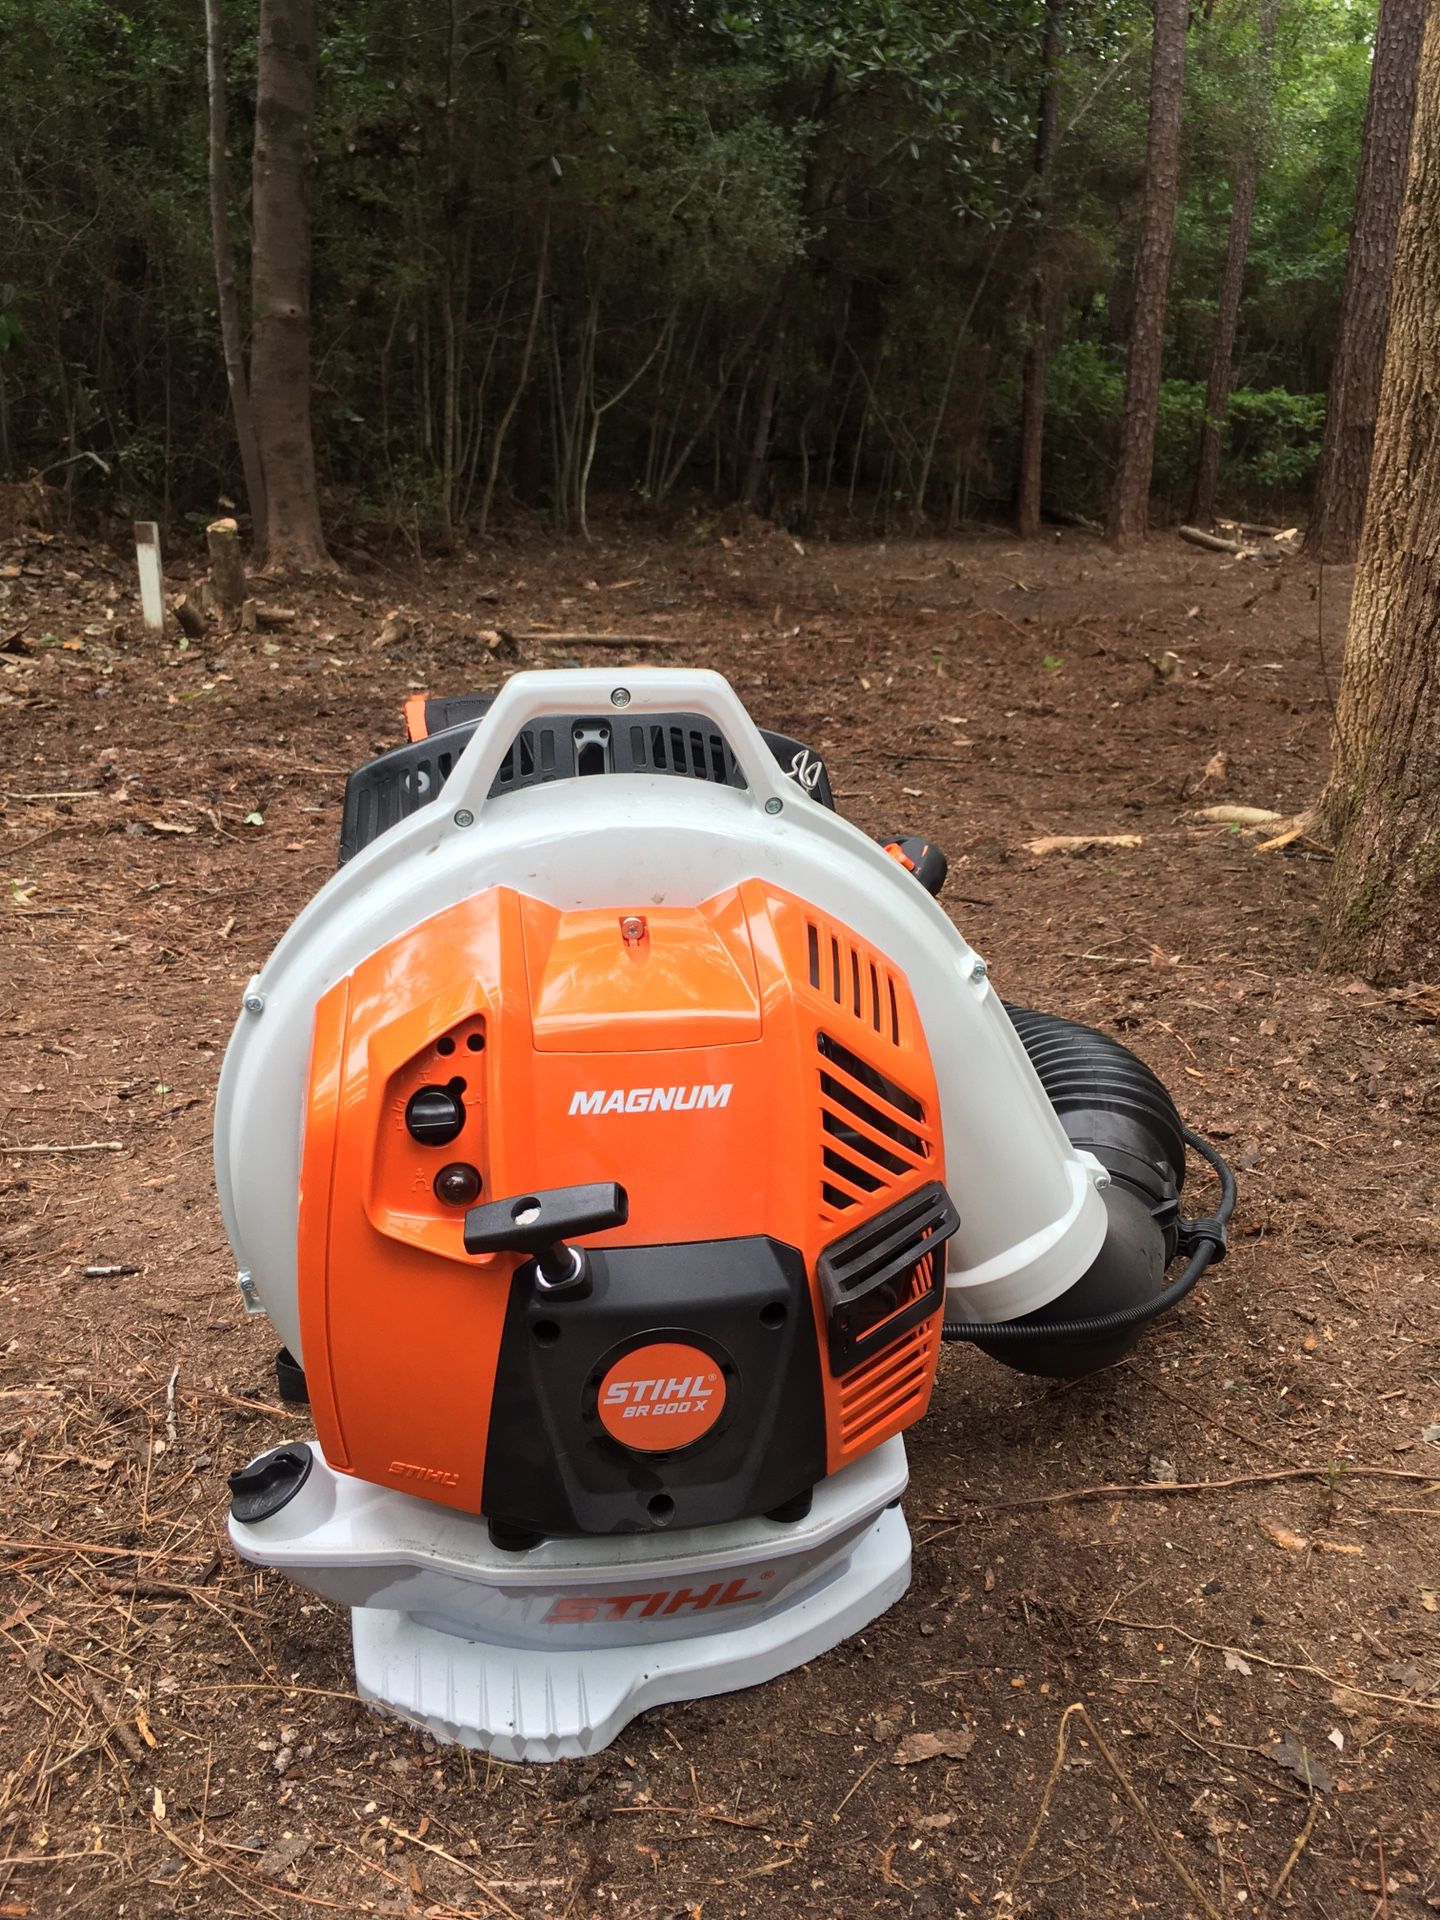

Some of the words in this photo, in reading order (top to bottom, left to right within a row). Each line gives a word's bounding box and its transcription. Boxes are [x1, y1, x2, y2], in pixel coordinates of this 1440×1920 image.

[568, 1083, 734, 1116] MAGNUM
[622, 1405, 650, 1418] BR
[652, 1401, 691, 1415] 800
[693, 1400, 708, 1411] X
